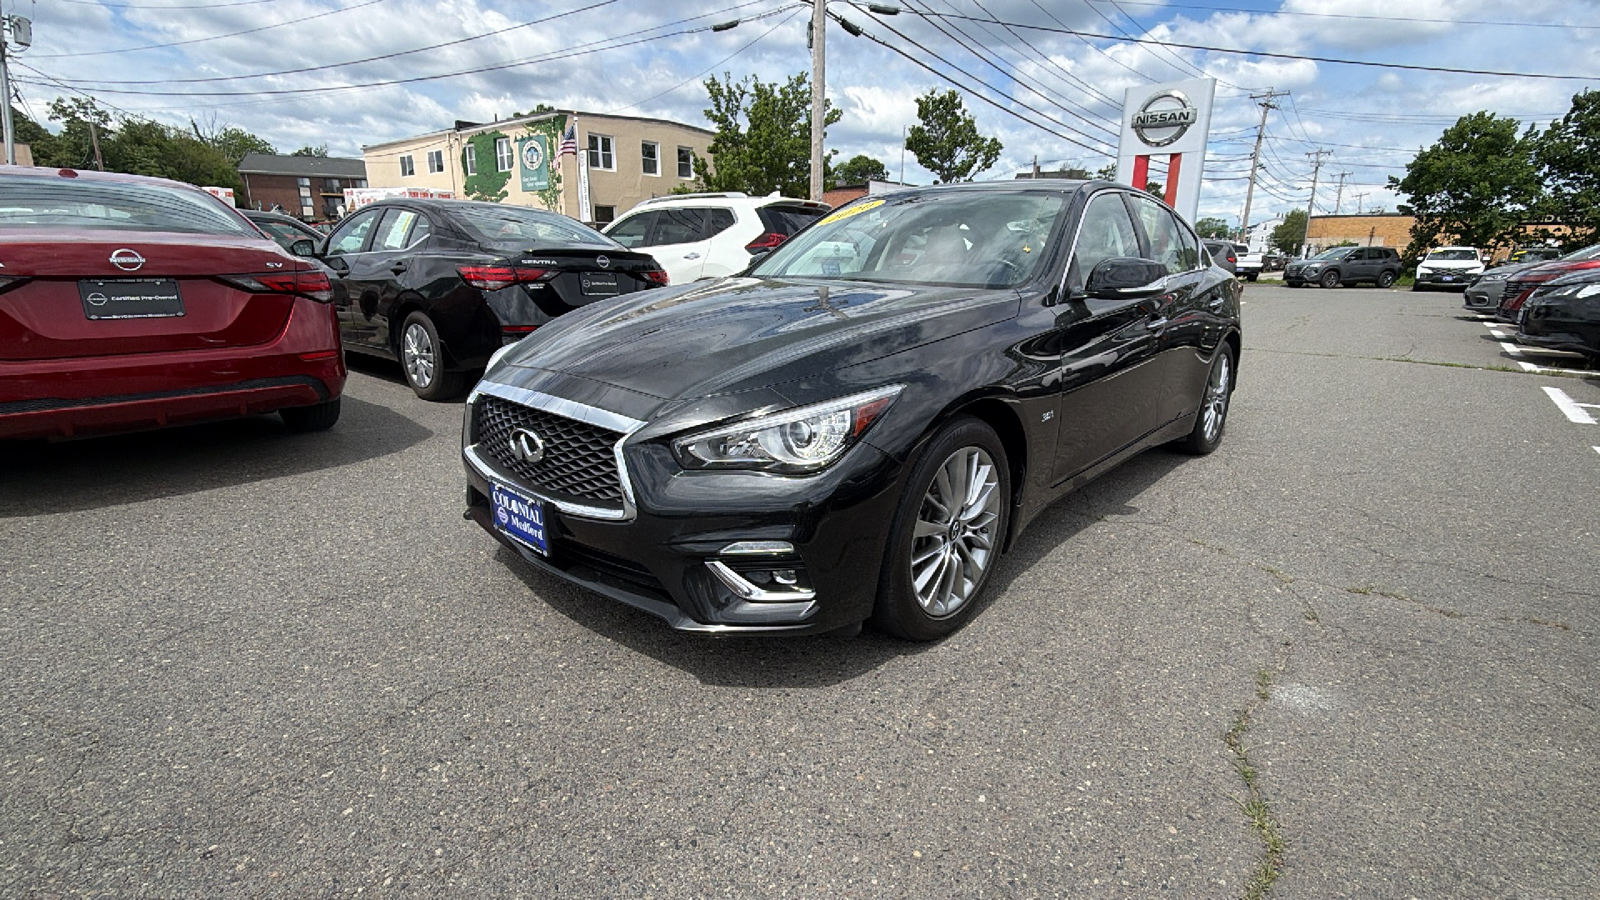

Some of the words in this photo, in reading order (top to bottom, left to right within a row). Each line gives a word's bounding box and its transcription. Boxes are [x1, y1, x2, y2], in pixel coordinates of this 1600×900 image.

[1136, 111, 1190, 124] NISSAN
[492, 490, 544, 527] COLONIAL
[511, 514, 544, 541] Medford
